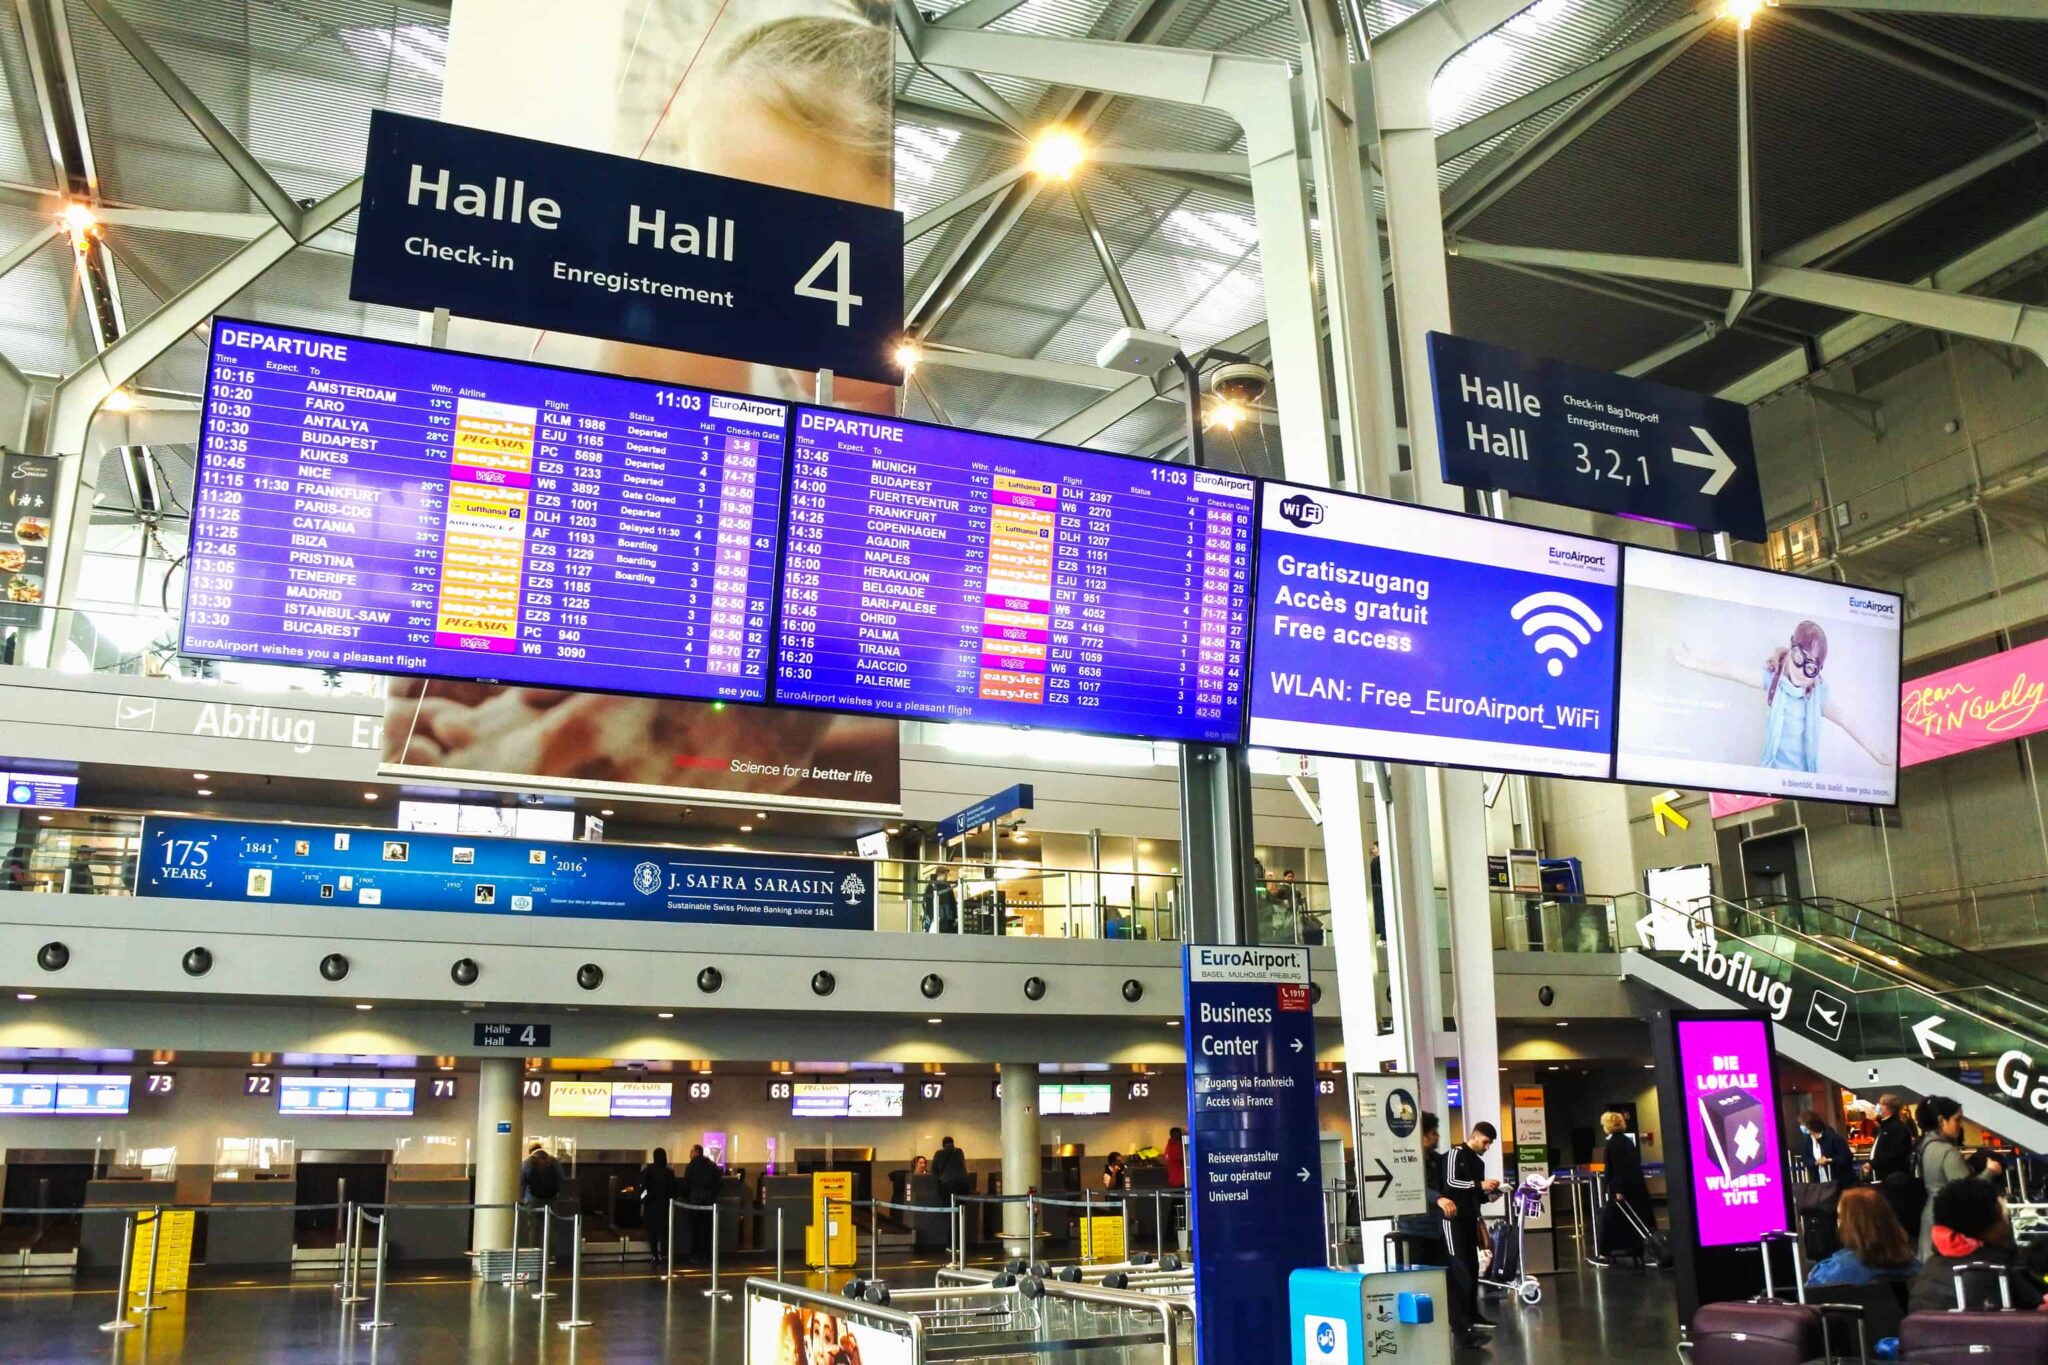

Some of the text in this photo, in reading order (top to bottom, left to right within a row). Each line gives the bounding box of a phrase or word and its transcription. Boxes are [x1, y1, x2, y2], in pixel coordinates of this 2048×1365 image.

[407, 164, 863, 327] Halle Hall 4
[404, 237, 734, 308] Check-in Enregistrement
[221, 328, 347, 361] DEPARTURE
[214, 367, 396, 402] 10:15 AMSTERDAM
[212, 384, 344, 412] 10:20 FARO
[655, 390, 700, 410] 11:03
[1460, 373, 1541, 417] Halle
[210, 401, 369, 432] 10:30 ANTALYA
[1563, 395, 1659, 424] Check-in Bag Drop-off
[208, 418, 378, 450] 10:30 BUDAPEST
[800, 413, 903, 442] DEPARTURE
[1567, 414, 1639, 438] Enregistrement
[206, 436, 348, 464] 10:35 KUKES
[1466, 421, 1528, 461] Hall
[204, 453, 331, 479] 10:45 NICE
[871, 458, 916, 474] MUNICH
[202, 470, 380, 501] 11:15 11:30 FRANKFURT
[870, 474, 932, 491] BUDAPEST
[1150, 467, 1187, 485] 11:03
[200, 488, 371, 517] 11:20 PARIS-CDG
[869, 489, 958, 511] FUERTEVENTUR
[199, 505, 354, 533] 11:25 CATANIA
[868, 504, 937, 522] FRANKFURT
[197, 522, 327, 548] 11:25 IBIZA
[866, 520, 946, 539] COPENHAGEN
[865, 534, 910, 550] AGADIR
[195, 540, 354, 568] 12:45 PRISTINA
[864, 550, 910, 565] NAPLES
[193, 558, 356, 585] 13:05 TENERIFE
[863, 565, 929, 582] HERAKLION
[1277, 554, 1429, 600] Gratiszugang
[191, 575, 342, 601] 13:30 MADRID
[862, 580, 925, 598] BELGRADE
[190, 592, 391, 623] 13:30 ISTANBUL-SAW
[861, 596, 937, 614] BARI-PALESE
[1275, 585, 1428, 625] Accès gratuit
[189, 610, 361, 637] 13:30 BUCAREST
[860, 611, 896, 625] OHRID
[858, 627, 899, 641] PALMA
[1274, 615, 1412, 652] Free access
[858, 642, 900, 656] TIRANA
[856, 658, 907, 672] AJACCIO
[855, 673, 911, 688] PALERME
[1270, 672, 1352, 702] WLAN:
[1360, 682, 1600, 730] Free_EuroAirport_WiFi
[193, 702, 315, 754] Abflug
[730, 759, 780, 776] Science
[783, 764, 800, 776] for
[802, 769, 810, 778] a
[812, 767, 851, 781] better
[853, 770, 873, 783] life
[162, 839, 209, 866] 175
[246, 841, 272, 854] 1841
[162, 866, 207, 880] YEARS
[557, 862, 582, 873] 2016
[668, 872, 834, 895] J. SAFRA SARASIN
[668, 902, 711, 910] Sustainable
[714, 904, 734, 912] Swiss
[736, 904, 762, 912] Private
[764, 906, 792, 915] Banking
[1680, 937, 1792, 1020] Abflug
[1200, 1002, 1272, 1023] Business
[484, 1024, 511, 1034] Halle
[520, 1026, 536, 1046] 4
[484, 1036, 504, 1046] Hall
[1202, 1034, 1258, 1056] Center
[1712, 1056, 1738, 1071] DIE
[148, 1075, 172, 1092] 73
[248, 1076, 270, 1093] 72
[434, 1080, 454, 1097] 71
[524, 1081, 541, 1097] 70
[690, 1082, 710, 1098] 69
[770, 1084, 790, 1099] 68
[924, 1083, 942, 1098] 67
[1132, 1082, 1150, 1097] 65
[1205, 1076, 1294, 1090] Zugang via Frankreich
[1320, 1081, 1334, 1094] 63
[1697, 1074, 1758, 1090] LOKALE
[1206, 1095, 1274, 1106] Accès via France
[1208, 1150, 1279, 1164] Reiseveranstalter
[1209, 1170, 1272, 1184] Tour opérateur
[1209, 1189, 1248, 1202] Universal
[1722, 1188, 1758, 1206] TÜTE
